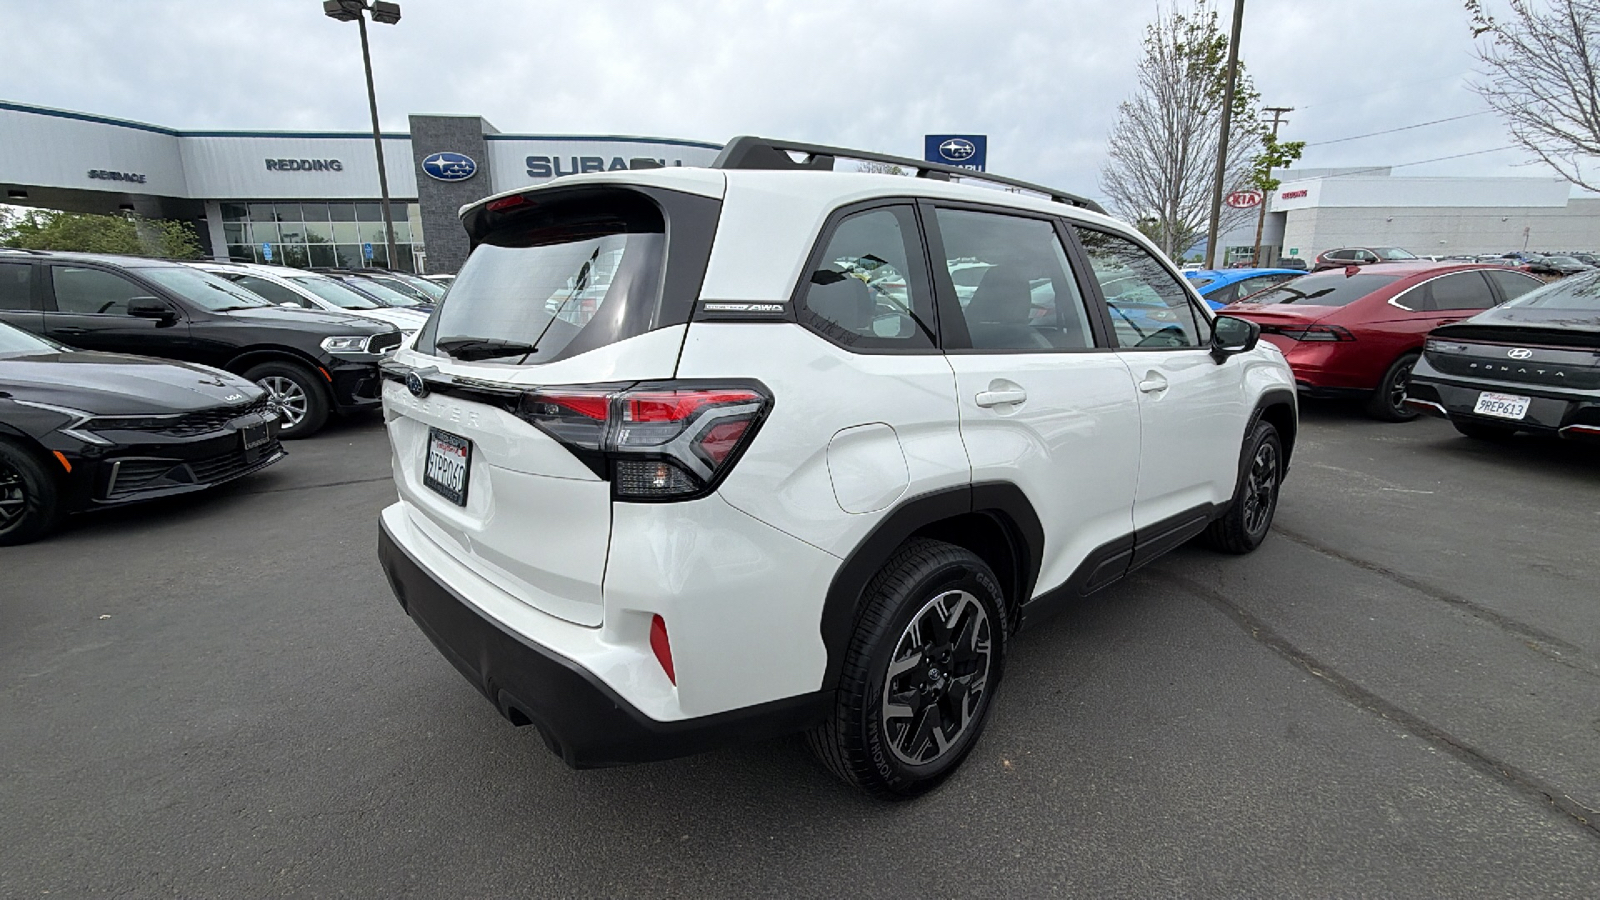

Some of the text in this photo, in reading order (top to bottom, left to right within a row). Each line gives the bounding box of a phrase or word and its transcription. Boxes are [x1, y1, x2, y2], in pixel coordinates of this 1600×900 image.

[265, 158, 343, 171] REDDING
[525, 156, 682, 178] SUBA
[87, 169, 147, 183] SERVICE
[1232, 194, 1256, 205] KIA
[1470, 363, 1564, 377] SONATA
[1478, 399, 1524, 416] 9REP613
